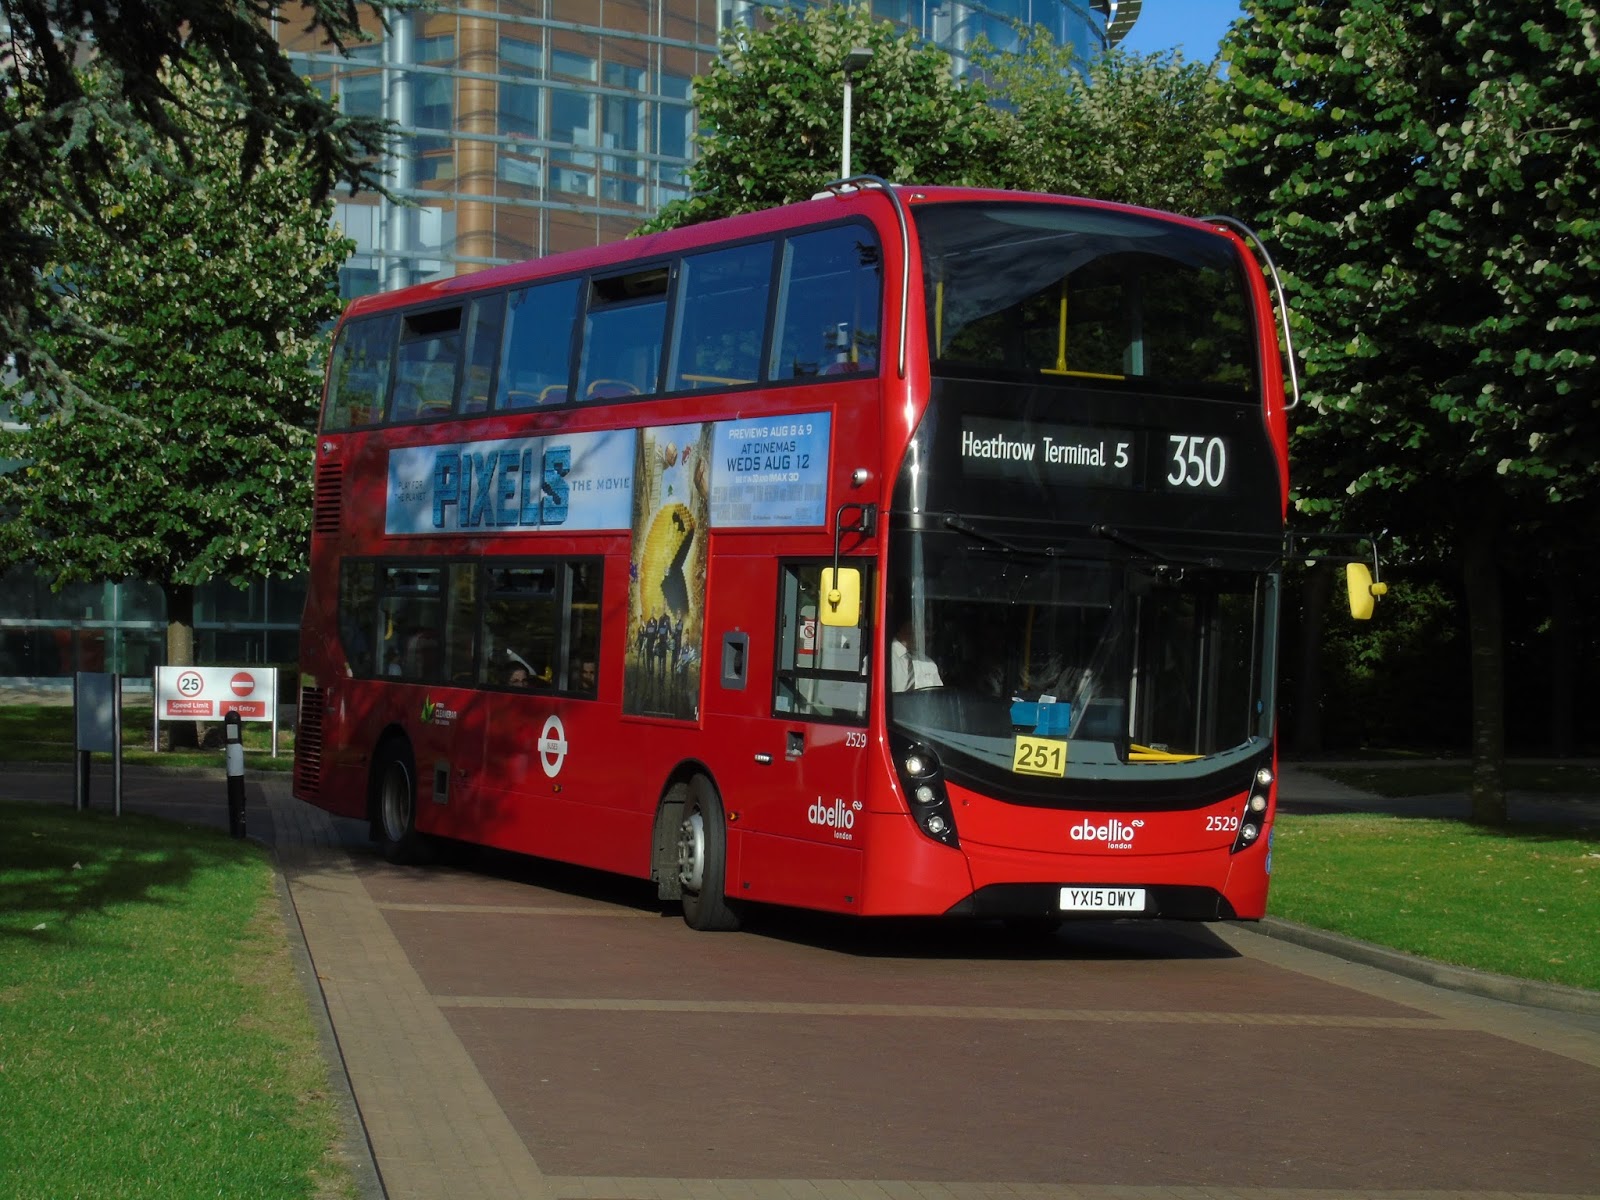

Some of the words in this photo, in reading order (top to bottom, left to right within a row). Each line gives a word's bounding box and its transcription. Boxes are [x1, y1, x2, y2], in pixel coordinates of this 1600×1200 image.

[728, 427, 768, 439] PREVIEWS
[770, 426, 788, 436] AUG
[790, 425, 796, 436] 8
[797, 424, 804, 436] &
[806, 423, 813, 435] 9
[741, 443, 752, 455] AT
[754, 441, 796, 454] CINEMAS
[962, 431, 1035, 461] Heathrow
[1043, 437, 1106, 467] Terminal
[1114, 443, 1129, 468] 5
[727, 456, 760, 472] WEDS
[764, 455, 790, 470] AUG
[796, 454, 810, 469] 12
[1167, 434, 1226, 487] 350
[572, 480, 592, 491] THE
[596, 477, 630, 490] MOVIE
[788, 472, 799, 482] 3D
[433, 445, 571, 528] PIXELS
[182, 678, 199, 691] 25
[238, 705, 256, 713] Entry
[846, 732, 867, 748] 2529
[1017, 743, 1060, 770] 251
[808, 796, 854, 829] abellio
[1070, 819, 1134, 841] abellio
[1205, 816, 1238, 831] 2529
[833, 830, 852, 840] london
[1071, 891, 1103, 906] YX15
[1107, 891, 1136, 907] OWY
